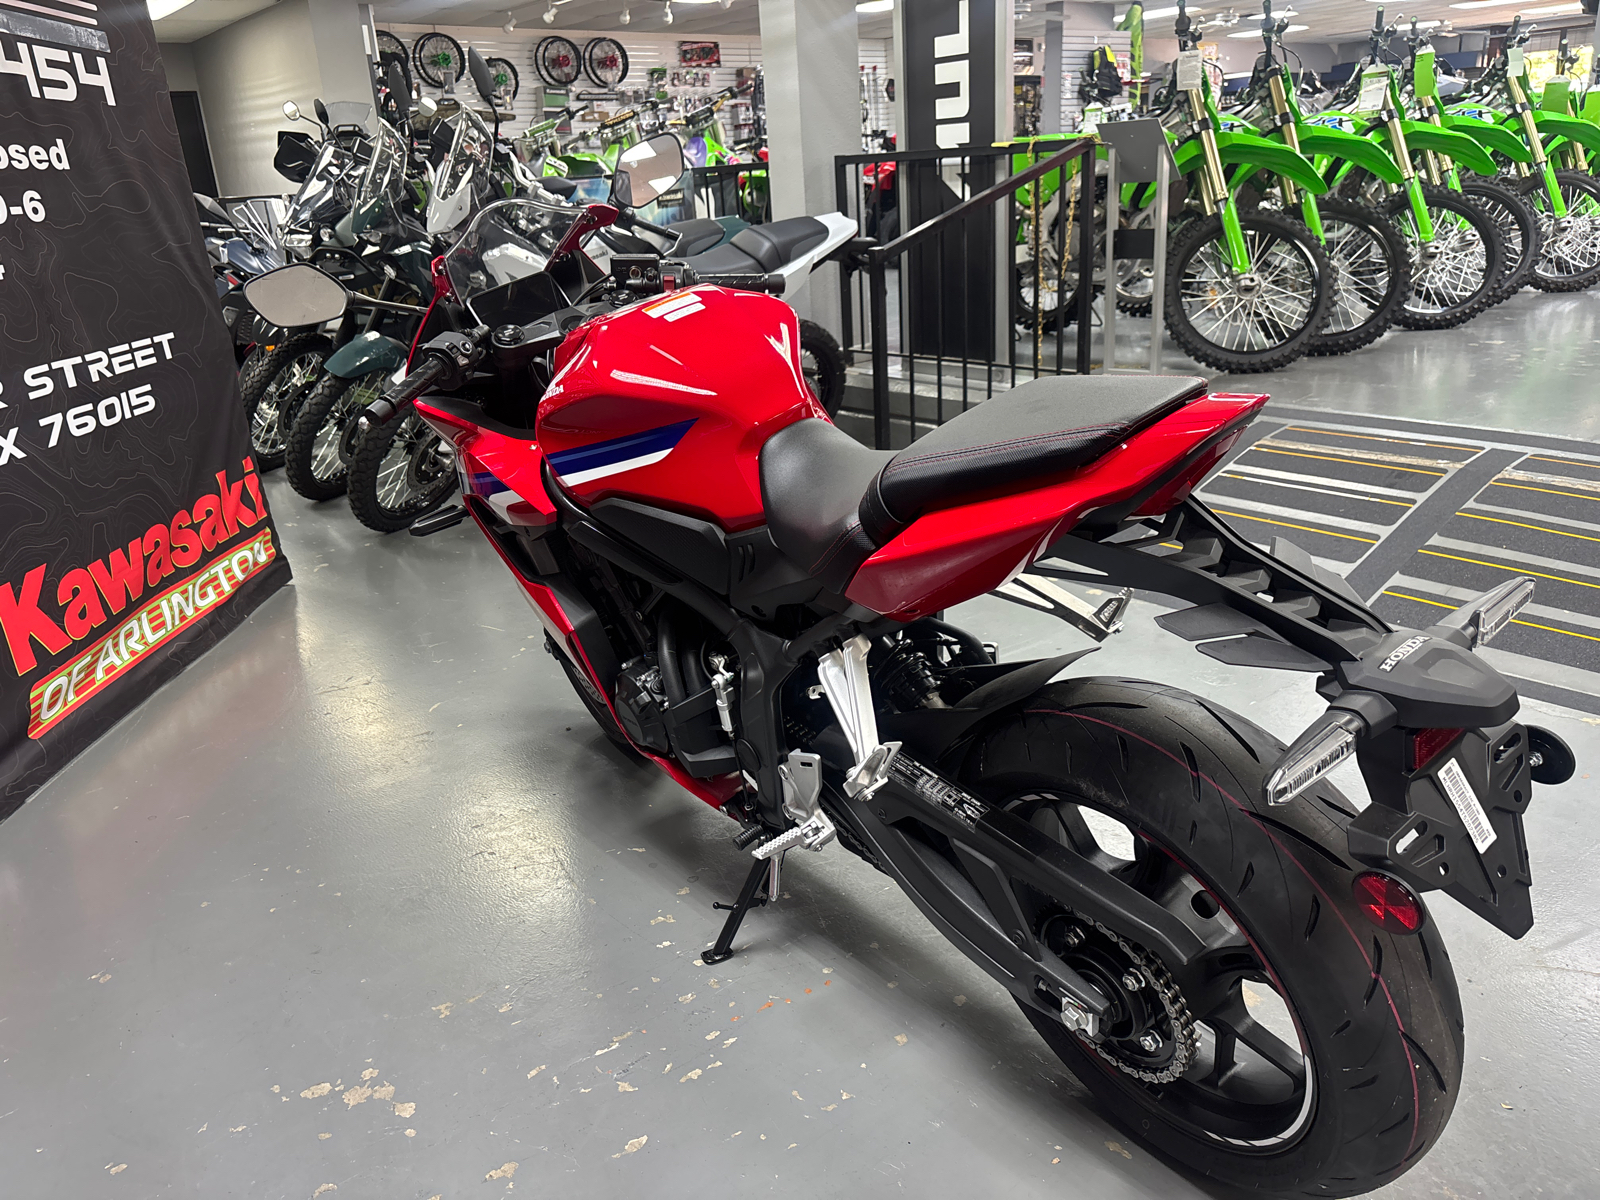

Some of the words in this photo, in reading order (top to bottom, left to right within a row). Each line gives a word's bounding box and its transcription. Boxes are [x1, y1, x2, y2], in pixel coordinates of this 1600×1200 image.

[0, 41, 116, 106] 454
[23, 331, 175, 400] STREET
[38, 383, 156, 448] 76015
[0, 455, 268, 676] Kawasaki
[40, 655, 92, 721] OF
[95, 540, 268, 681] ARLINGTON
[1379, 635, 1430, 672] HONDA
